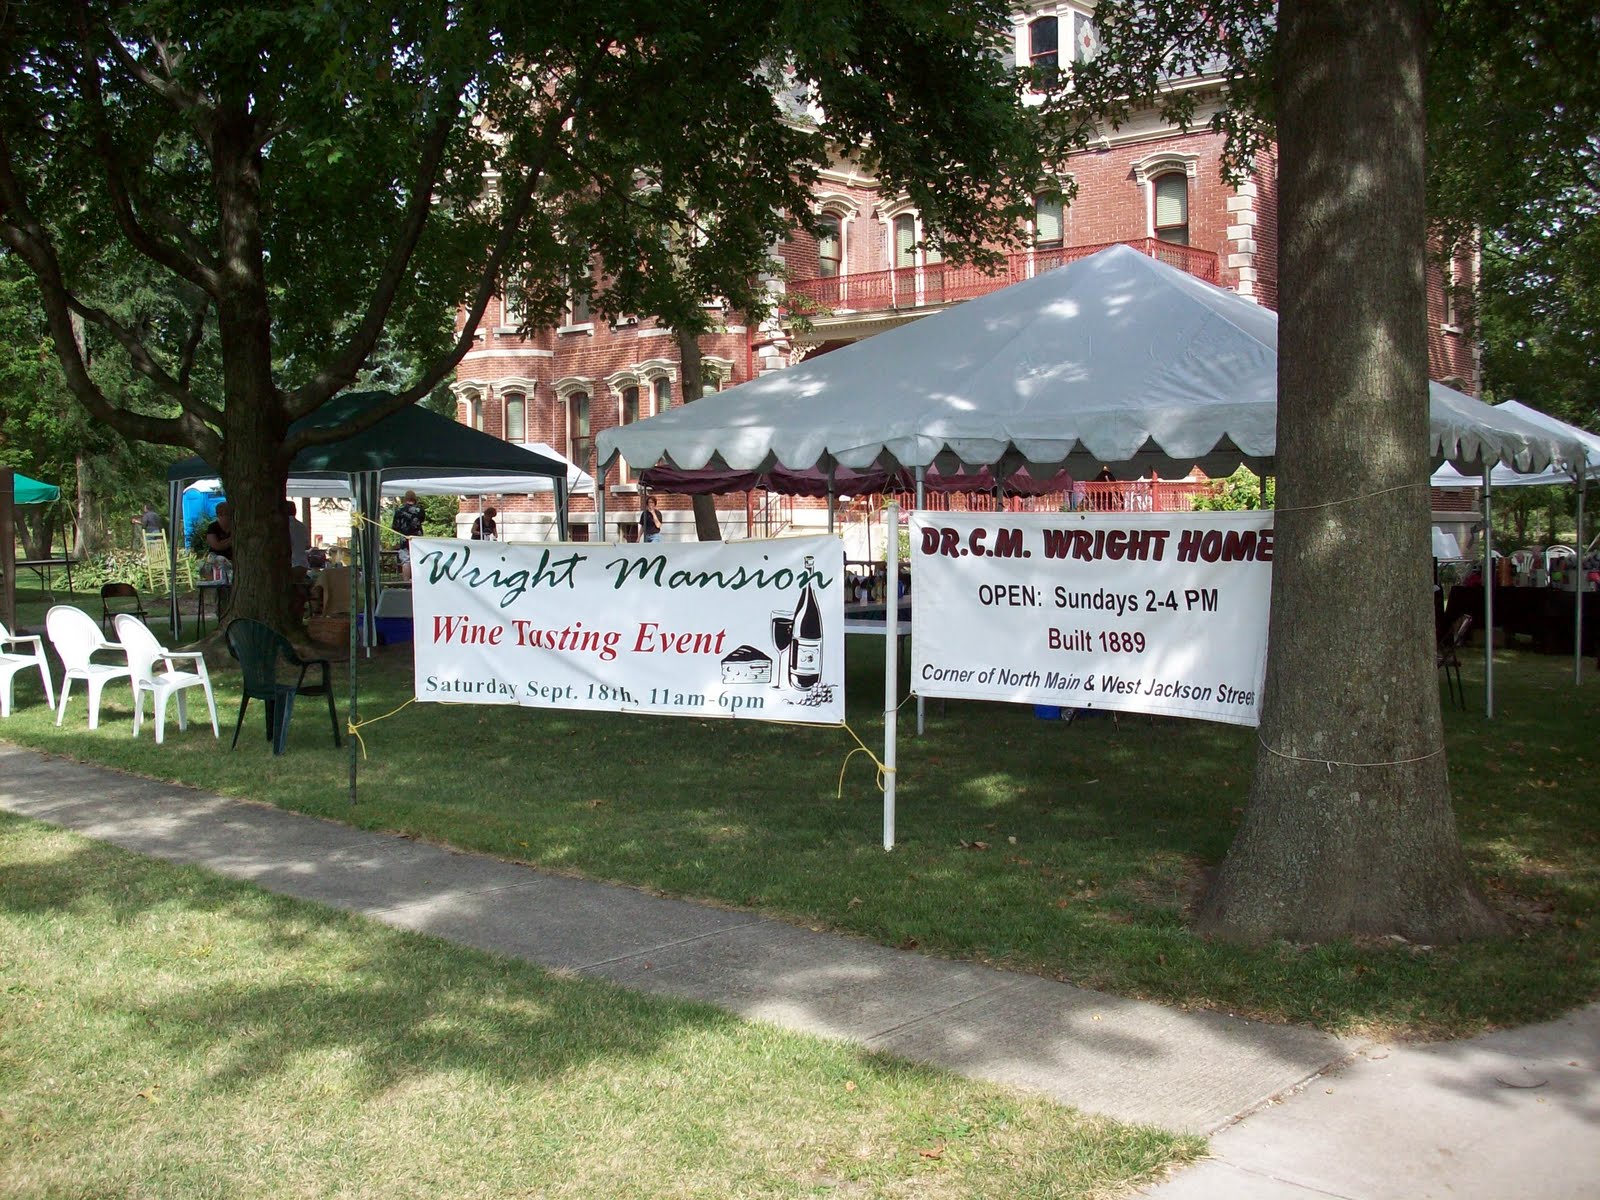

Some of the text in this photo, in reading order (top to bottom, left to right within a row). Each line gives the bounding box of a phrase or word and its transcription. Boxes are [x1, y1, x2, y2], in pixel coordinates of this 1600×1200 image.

[1043, 529, 1170, 562] WRIGHT
[1177, 529, 1274, 563] HOME
[419, 546, 834, 608] Wright Mansion
[978, 584, 1218, 617] OPEN: Sundays 2-4 PM
[432, 615, 727, 661] Wine Tasting Event
[1049, 628, 1146, 653] Built 1889
[426, 675, 764, 712] Saturday Sept. 18th, 11am-6pm
[922, 663, 975, 683] Corner
[977, 666, 995, 685] of
[997, 668, 1041, 688] North
[1045, 672, 1080, 691] Main
[1083, 673, 1095, 692] &
[1101, 676, 1141, 695] West
[1144, 679, 1212, 701] Jackson
